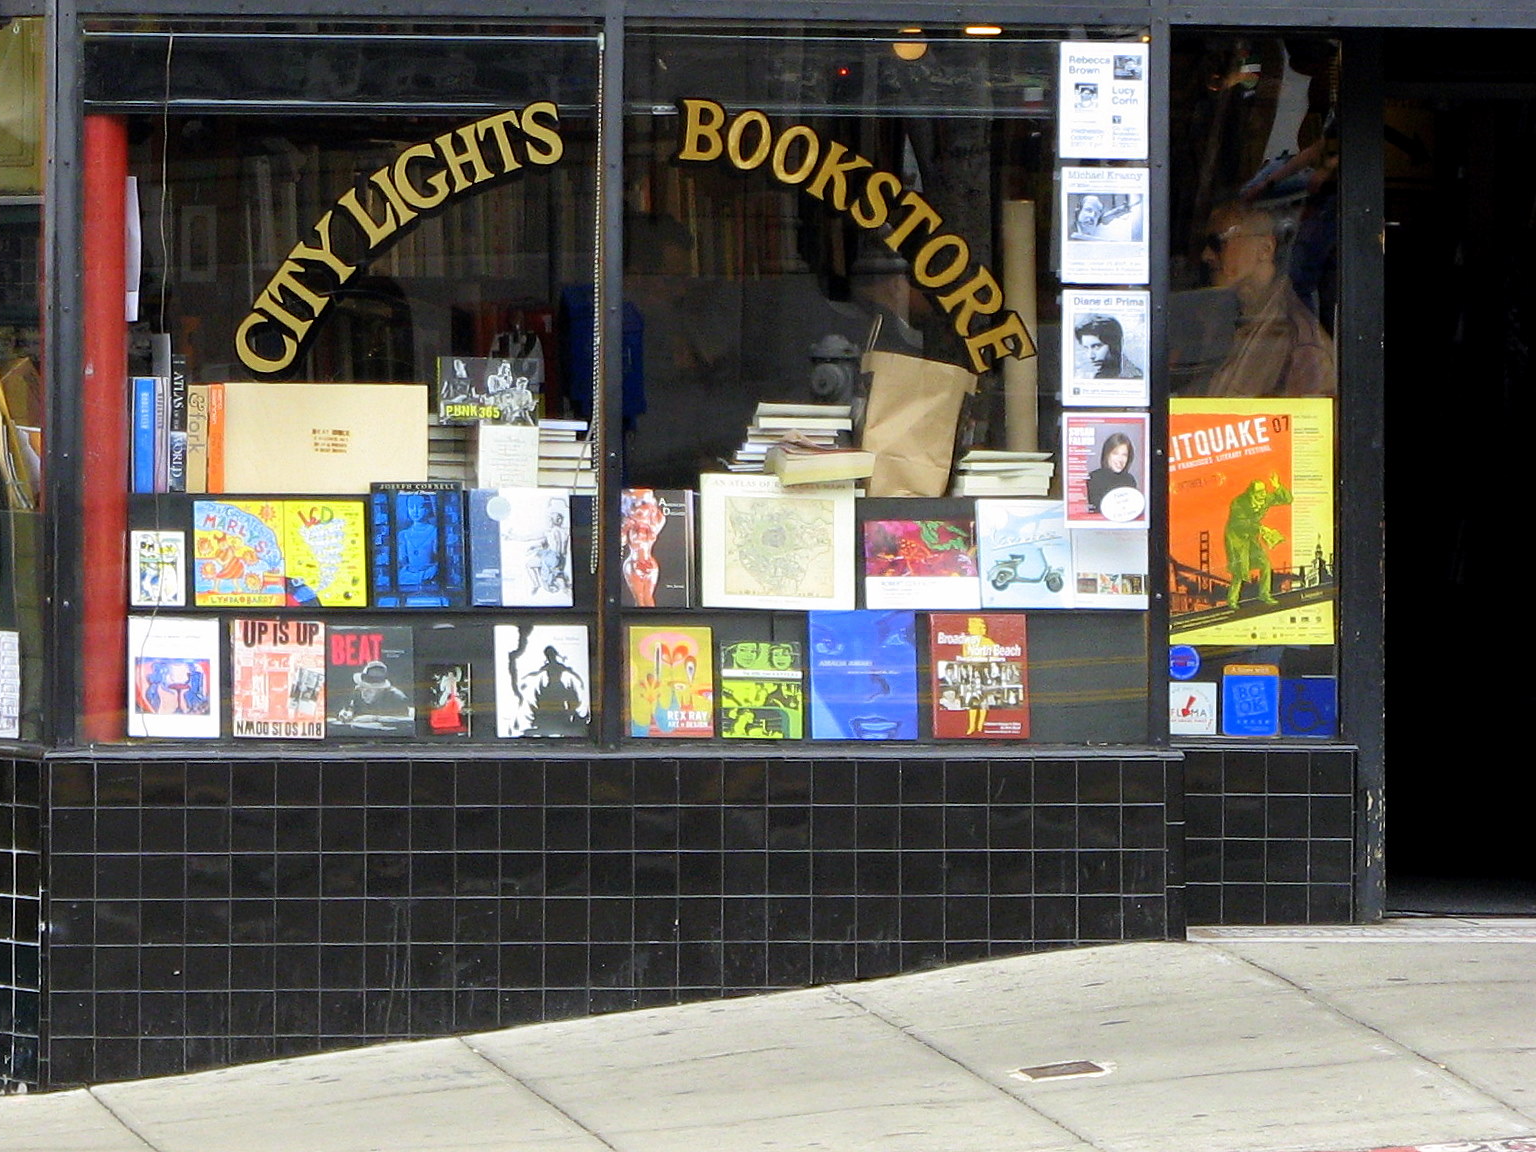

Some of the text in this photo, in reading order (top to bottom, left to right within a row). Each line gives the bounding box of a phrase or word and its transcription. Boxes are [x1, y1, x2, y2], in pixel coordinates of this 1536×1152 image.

[1068, 55, 1111, 65] Rebecca
[1068, 65, 1100, 74] Brown
[1112, 86, 1135, 98] Lucy
[1068, 170, 1143, 182] Michael Krasny
[234, 101, 565, 373] CITY LIGHTS
[678, 99, 1037, 375] BOOKSTORE
[1073, 296, 1101, 306] Diane
[1116, 297, 1145, 307] Prima
[445, 403, 501, 419] PUNK 365
[242, 621, 268, 648] UP
[296, 621, 320, 647] UP
[330, 634, 384, 666] BEAT
[667, 710, 708, 721] REX RAY
[236, 719, 322, 737] BUT SO IS DOWN
